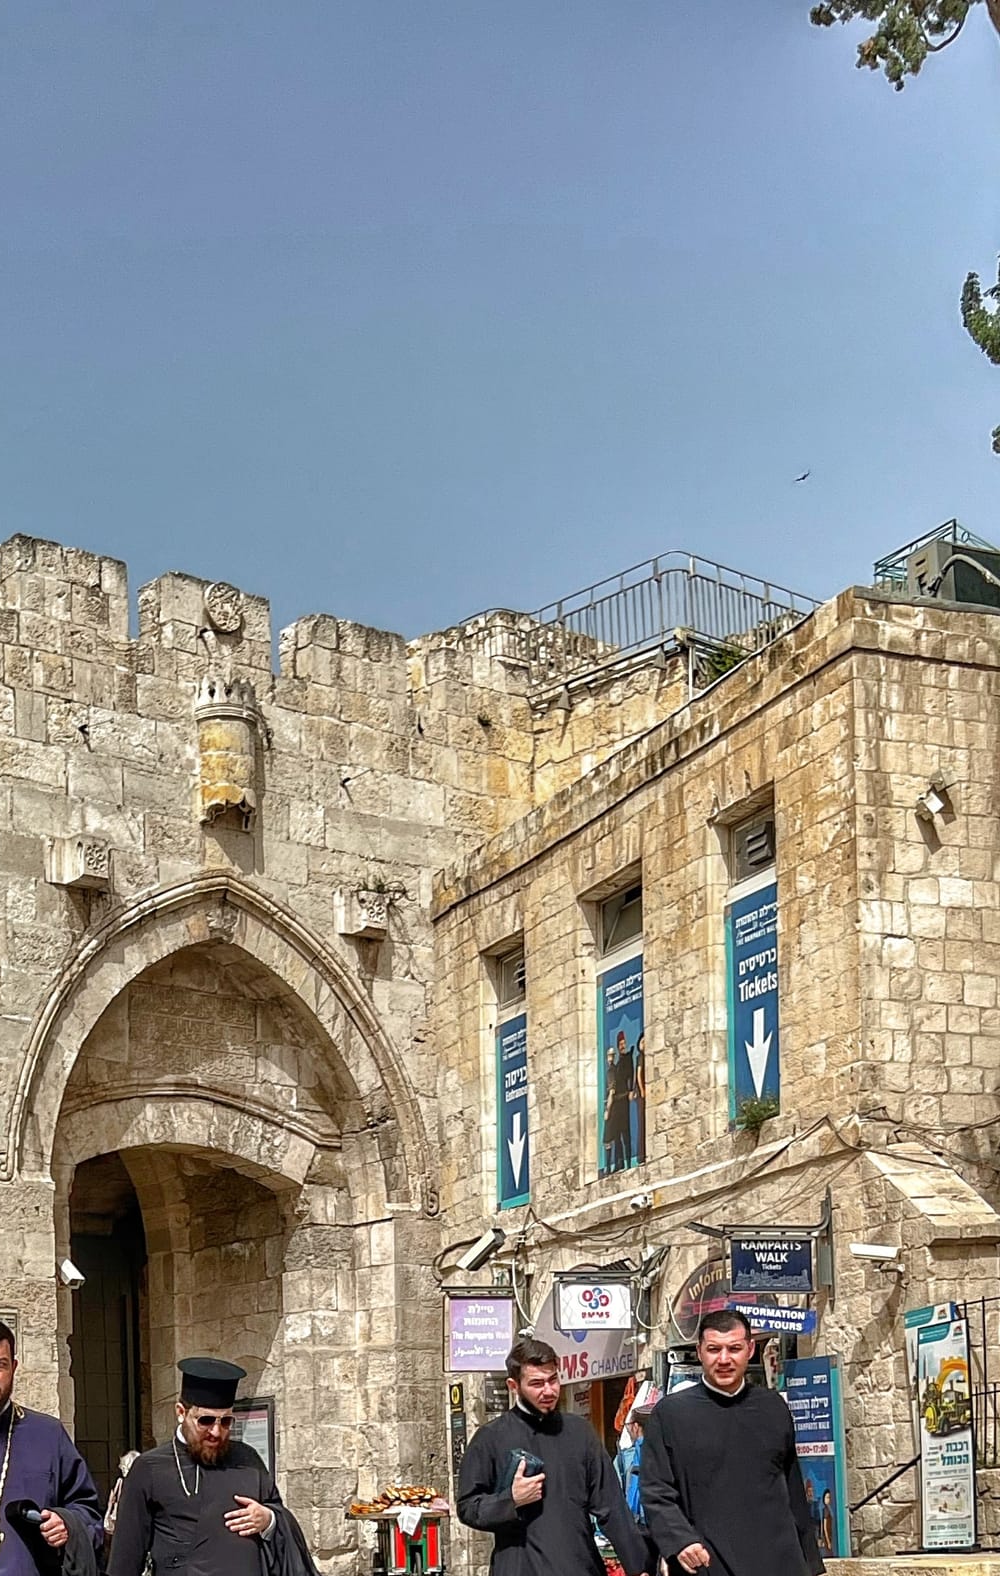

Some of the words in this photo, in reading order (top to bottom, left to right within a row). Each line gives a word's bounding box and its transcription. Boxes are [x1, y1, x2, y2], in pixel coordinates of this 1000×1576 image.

[739, 947, 777, 976] כרטיסים
[738, 971, 778, 1002] Tickets
[740, 1240, 802, 1251] RAMPARTS
[754, 1251, 788, 1263] WALK
[762, 1263, 782, 1271] Tickets
[688, 1267, 732, 1301] Informa
[467, 1304, 495, 1314] טיילת
[735, 1305, 806, 1320] INFORMATION
[463, 1317, 499, 1327] החומות
[768, 1320, 803, 1332] TOURS
[452, 1330, 463, 1340] The
[464, 1331, 495, 1341] Ramparts
[591, 1353, 633, 1376] CHANGE
[945, 1441, 969, 1453] רכבת
[940, 1453, 969, 1466] הכותל
